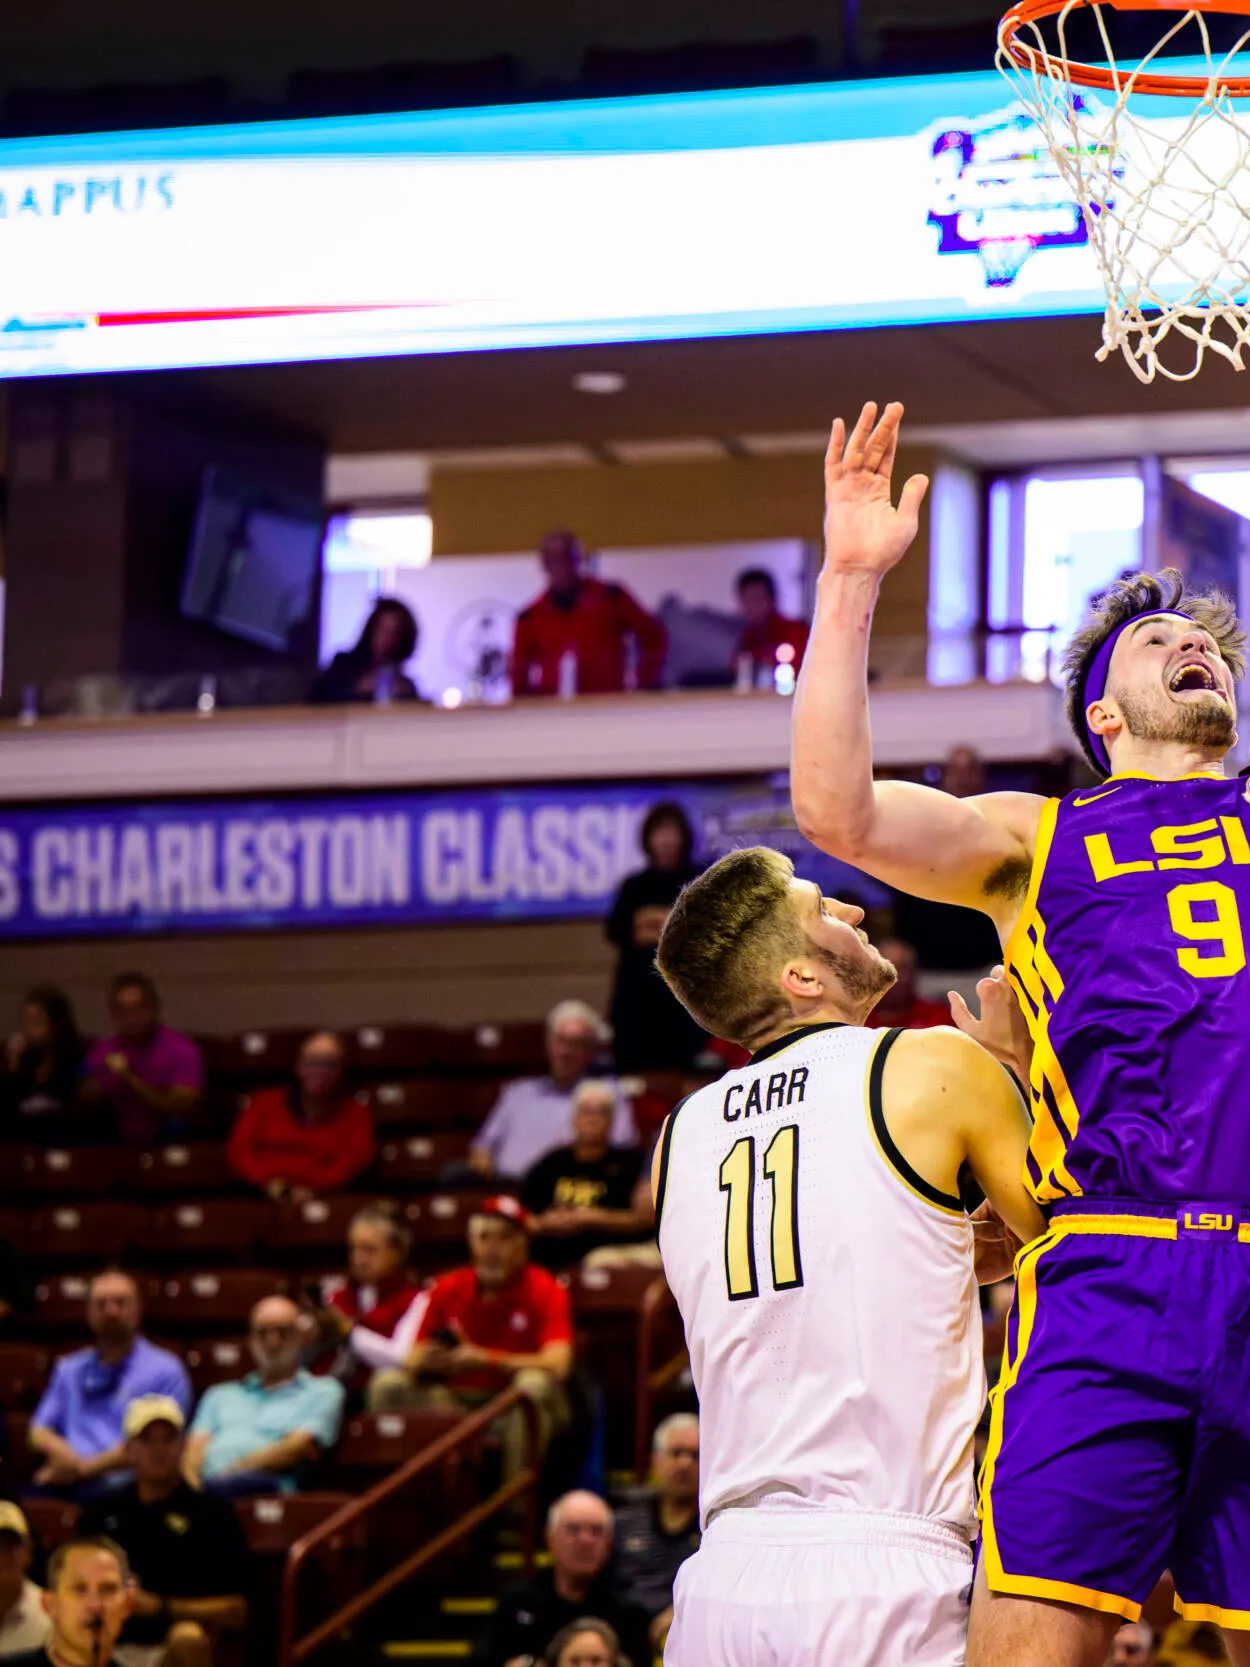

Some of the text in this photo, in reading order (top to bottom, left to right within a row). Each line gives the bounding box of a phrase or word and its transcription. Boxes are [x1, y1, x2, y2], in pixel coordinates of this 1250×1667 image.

[33, 812, 410, 917] CHARLESTON
[1166, 881, 1246, 978] 9
[723, 1067, 809, 1122] CARR
[719, 1124, 804, 1301] 11
[1184, 1212, 1233, 1231] LSU
